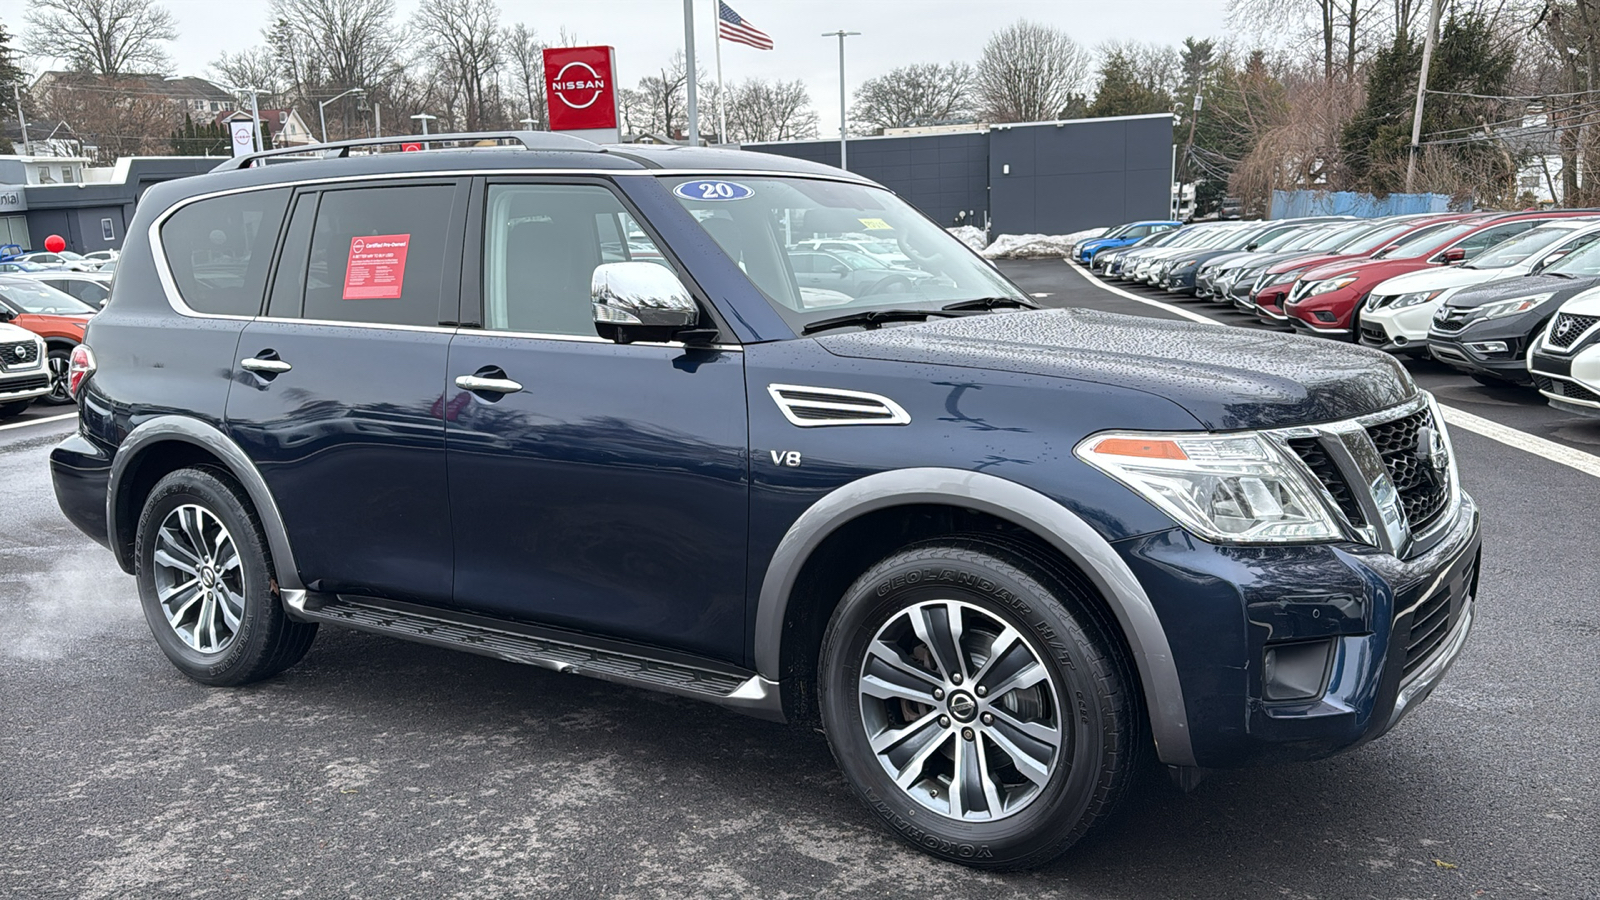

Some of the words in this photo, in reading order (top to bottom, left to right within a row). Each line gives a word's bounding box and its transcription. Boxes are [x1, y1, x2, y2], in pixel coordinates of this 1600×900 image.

[552, 80, 604, 91] NISSAN
[699, 182, 734, 198] 20
[770, 450, 801, 467] V8
[877, 569, 1031, 616] GEOLANDAR
[1035, 621, 1077, 671] H/T
[864, 786, 993, 858] YOKOHAMA
